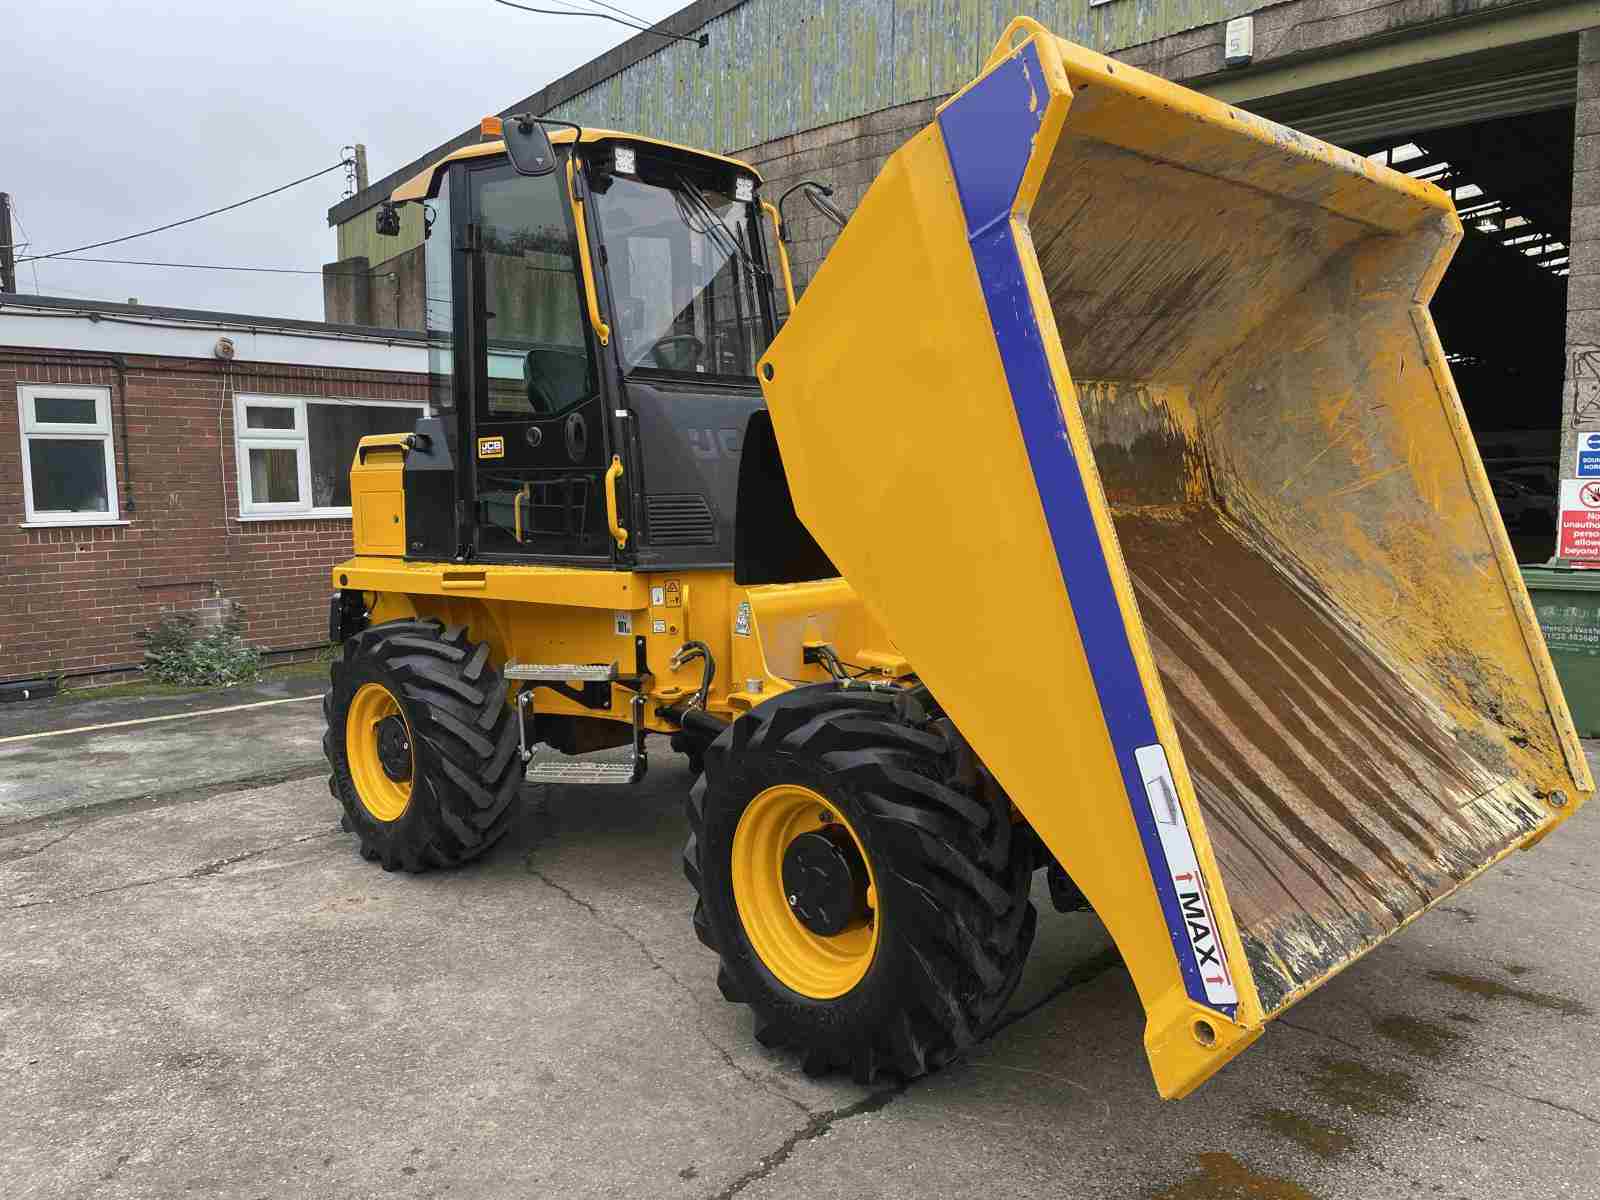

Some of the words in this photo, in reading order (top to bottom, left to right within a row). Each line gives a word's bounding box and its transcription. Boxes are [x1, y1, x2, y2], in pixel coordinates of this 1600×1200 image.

[481, 440, 502, 450] JCB
[1564, 547, 1599, 557] beyond
[1179, 892, 1220, 967] MAX
